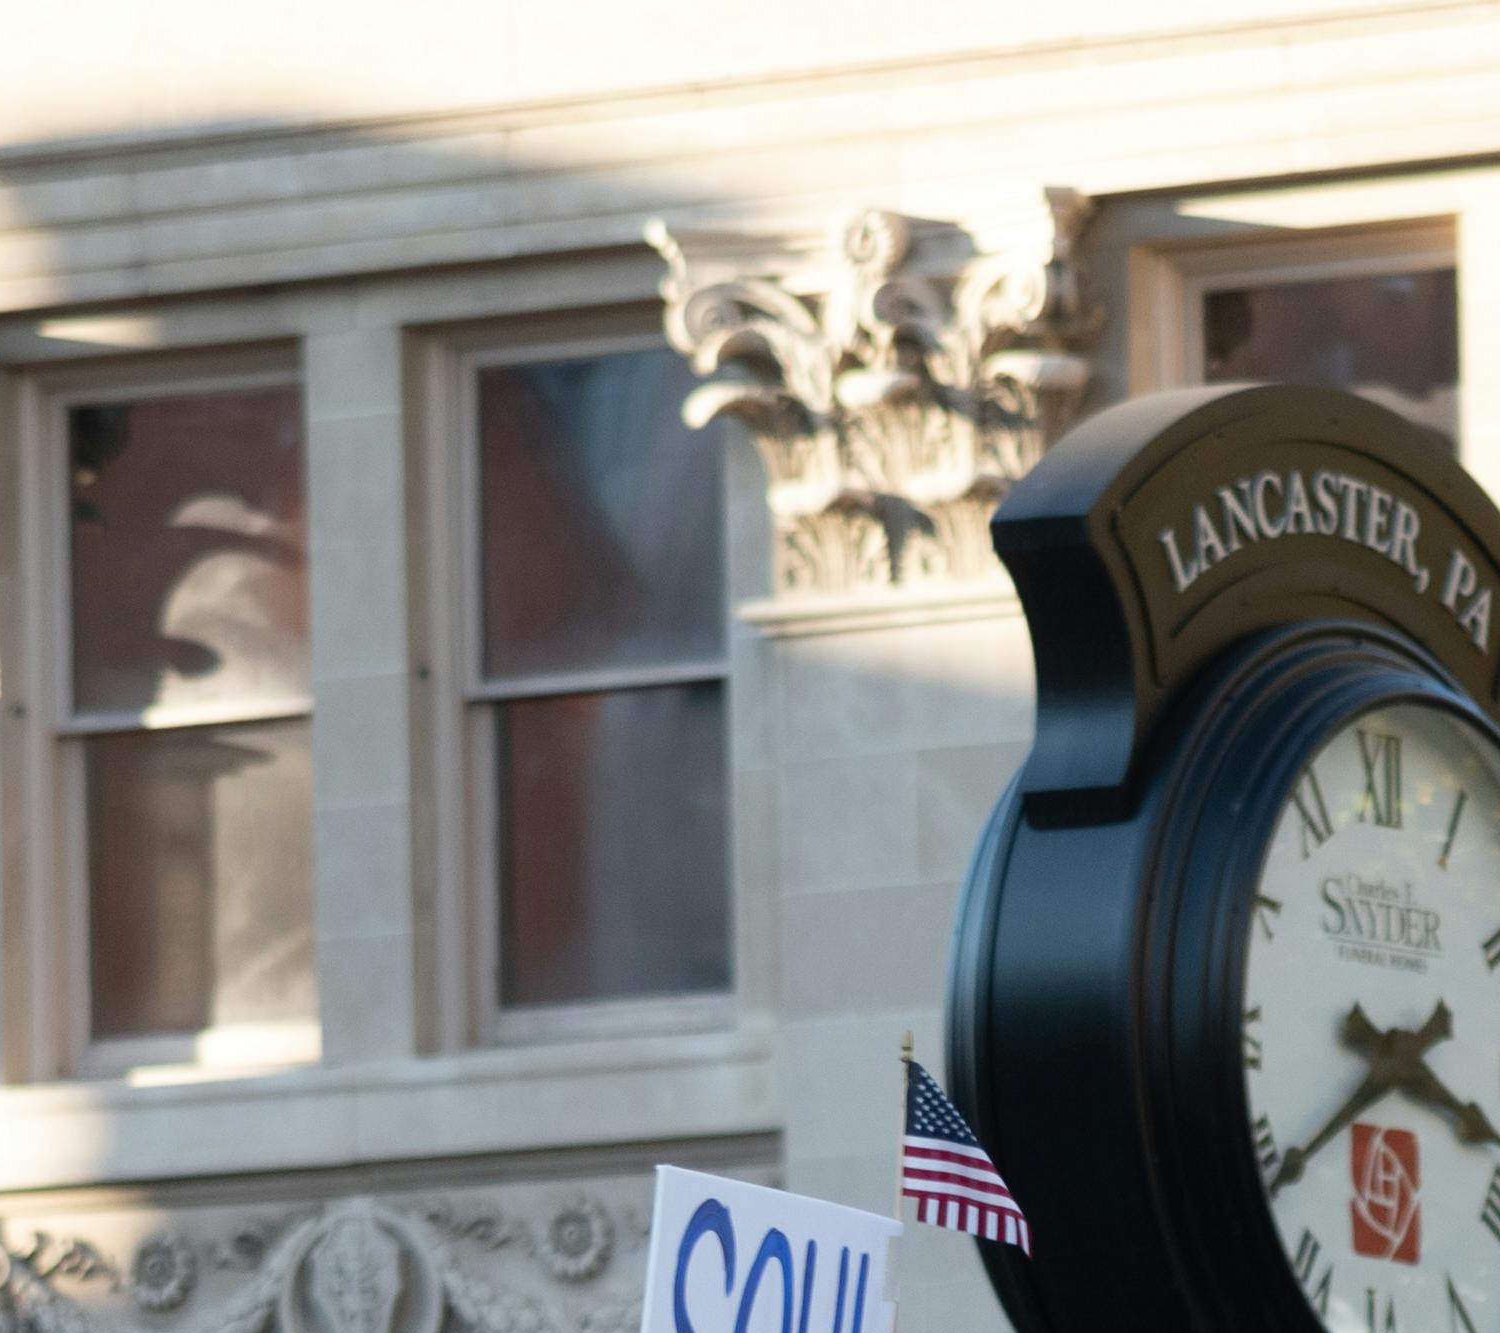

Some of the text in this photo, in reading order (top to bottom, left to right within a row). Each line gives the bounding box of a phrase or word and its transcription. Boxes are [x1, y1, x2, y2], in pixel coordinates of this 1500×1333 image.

[1157, 470, 1493, 655] LANCASTER, PA
[1321, 878, 1443, 951] SNYDER
